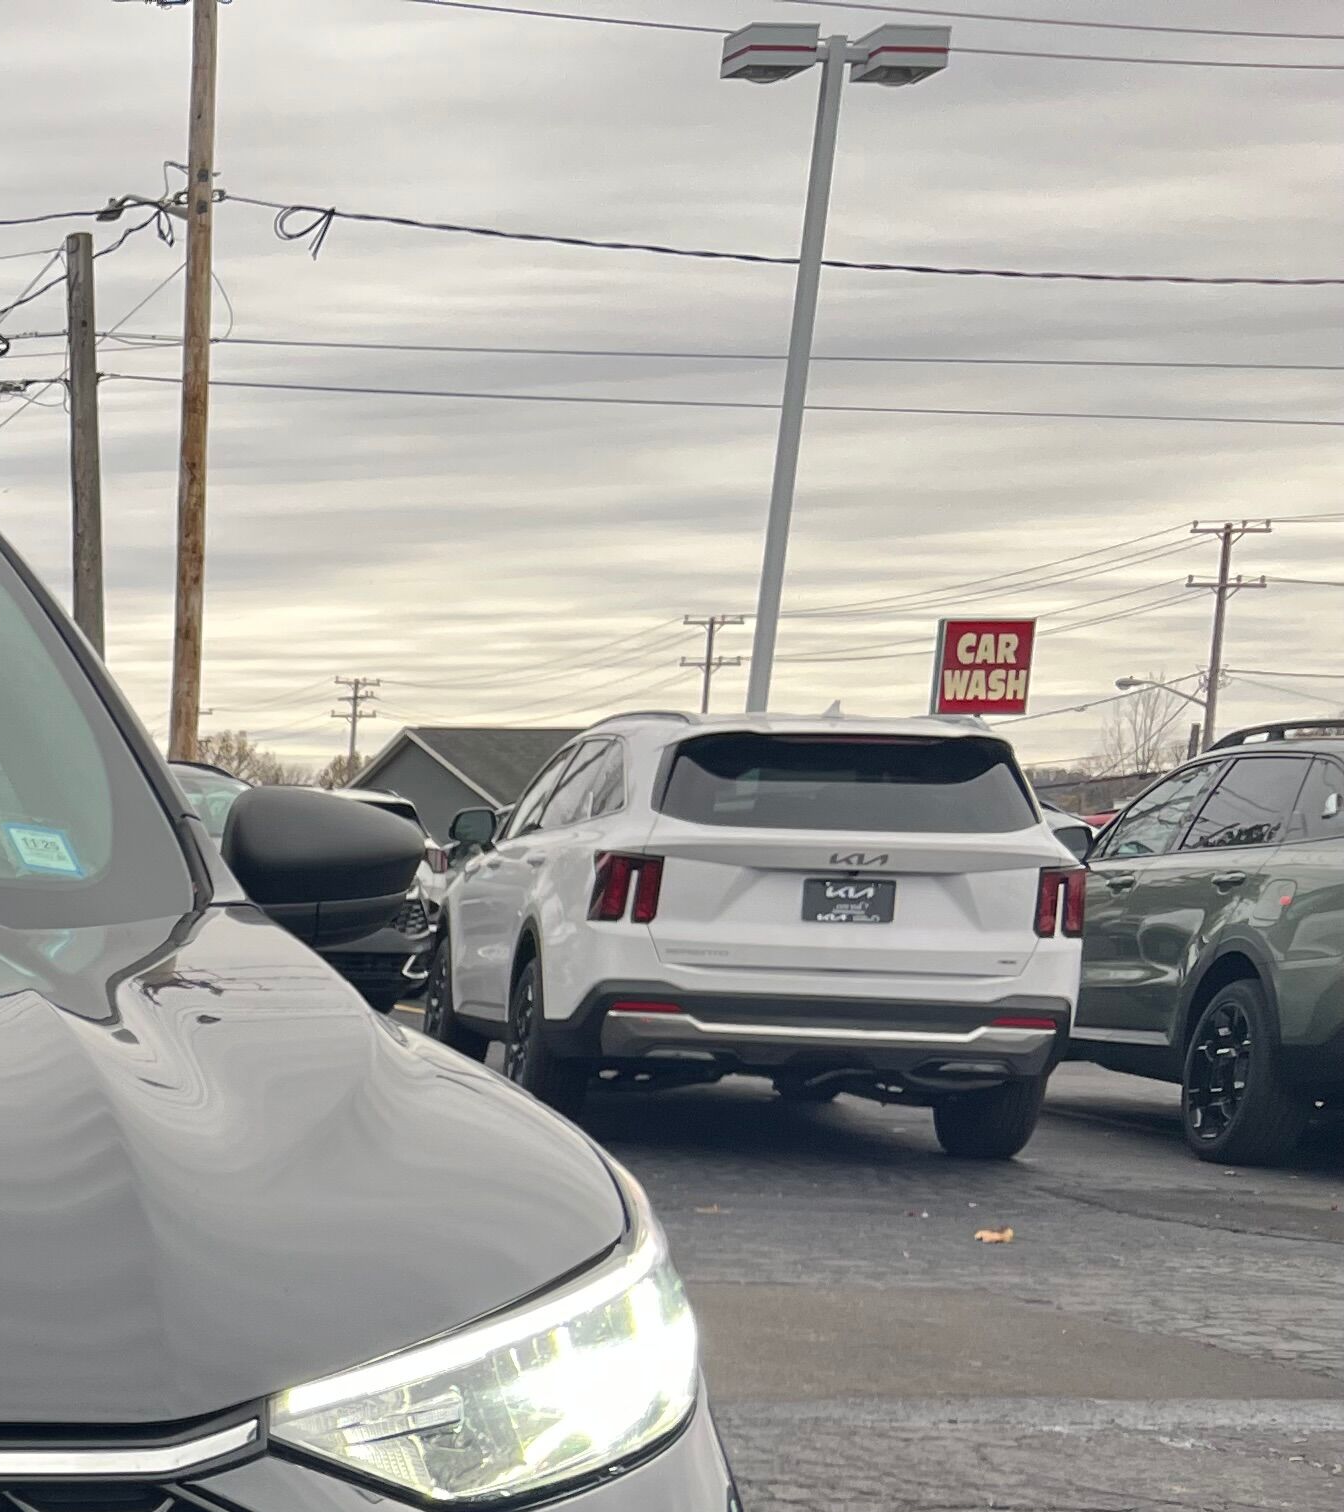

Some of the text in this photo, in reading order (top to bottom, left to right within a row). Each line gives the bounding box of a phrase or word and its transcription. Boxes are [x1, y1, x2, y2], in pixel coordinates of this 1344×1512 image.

[956, 632, 1019, 665] CAR
[943, 668, 1027, 701] WASH
[829, 852, 889, 866] KIA
[825, 885, 874, 899] KIA
